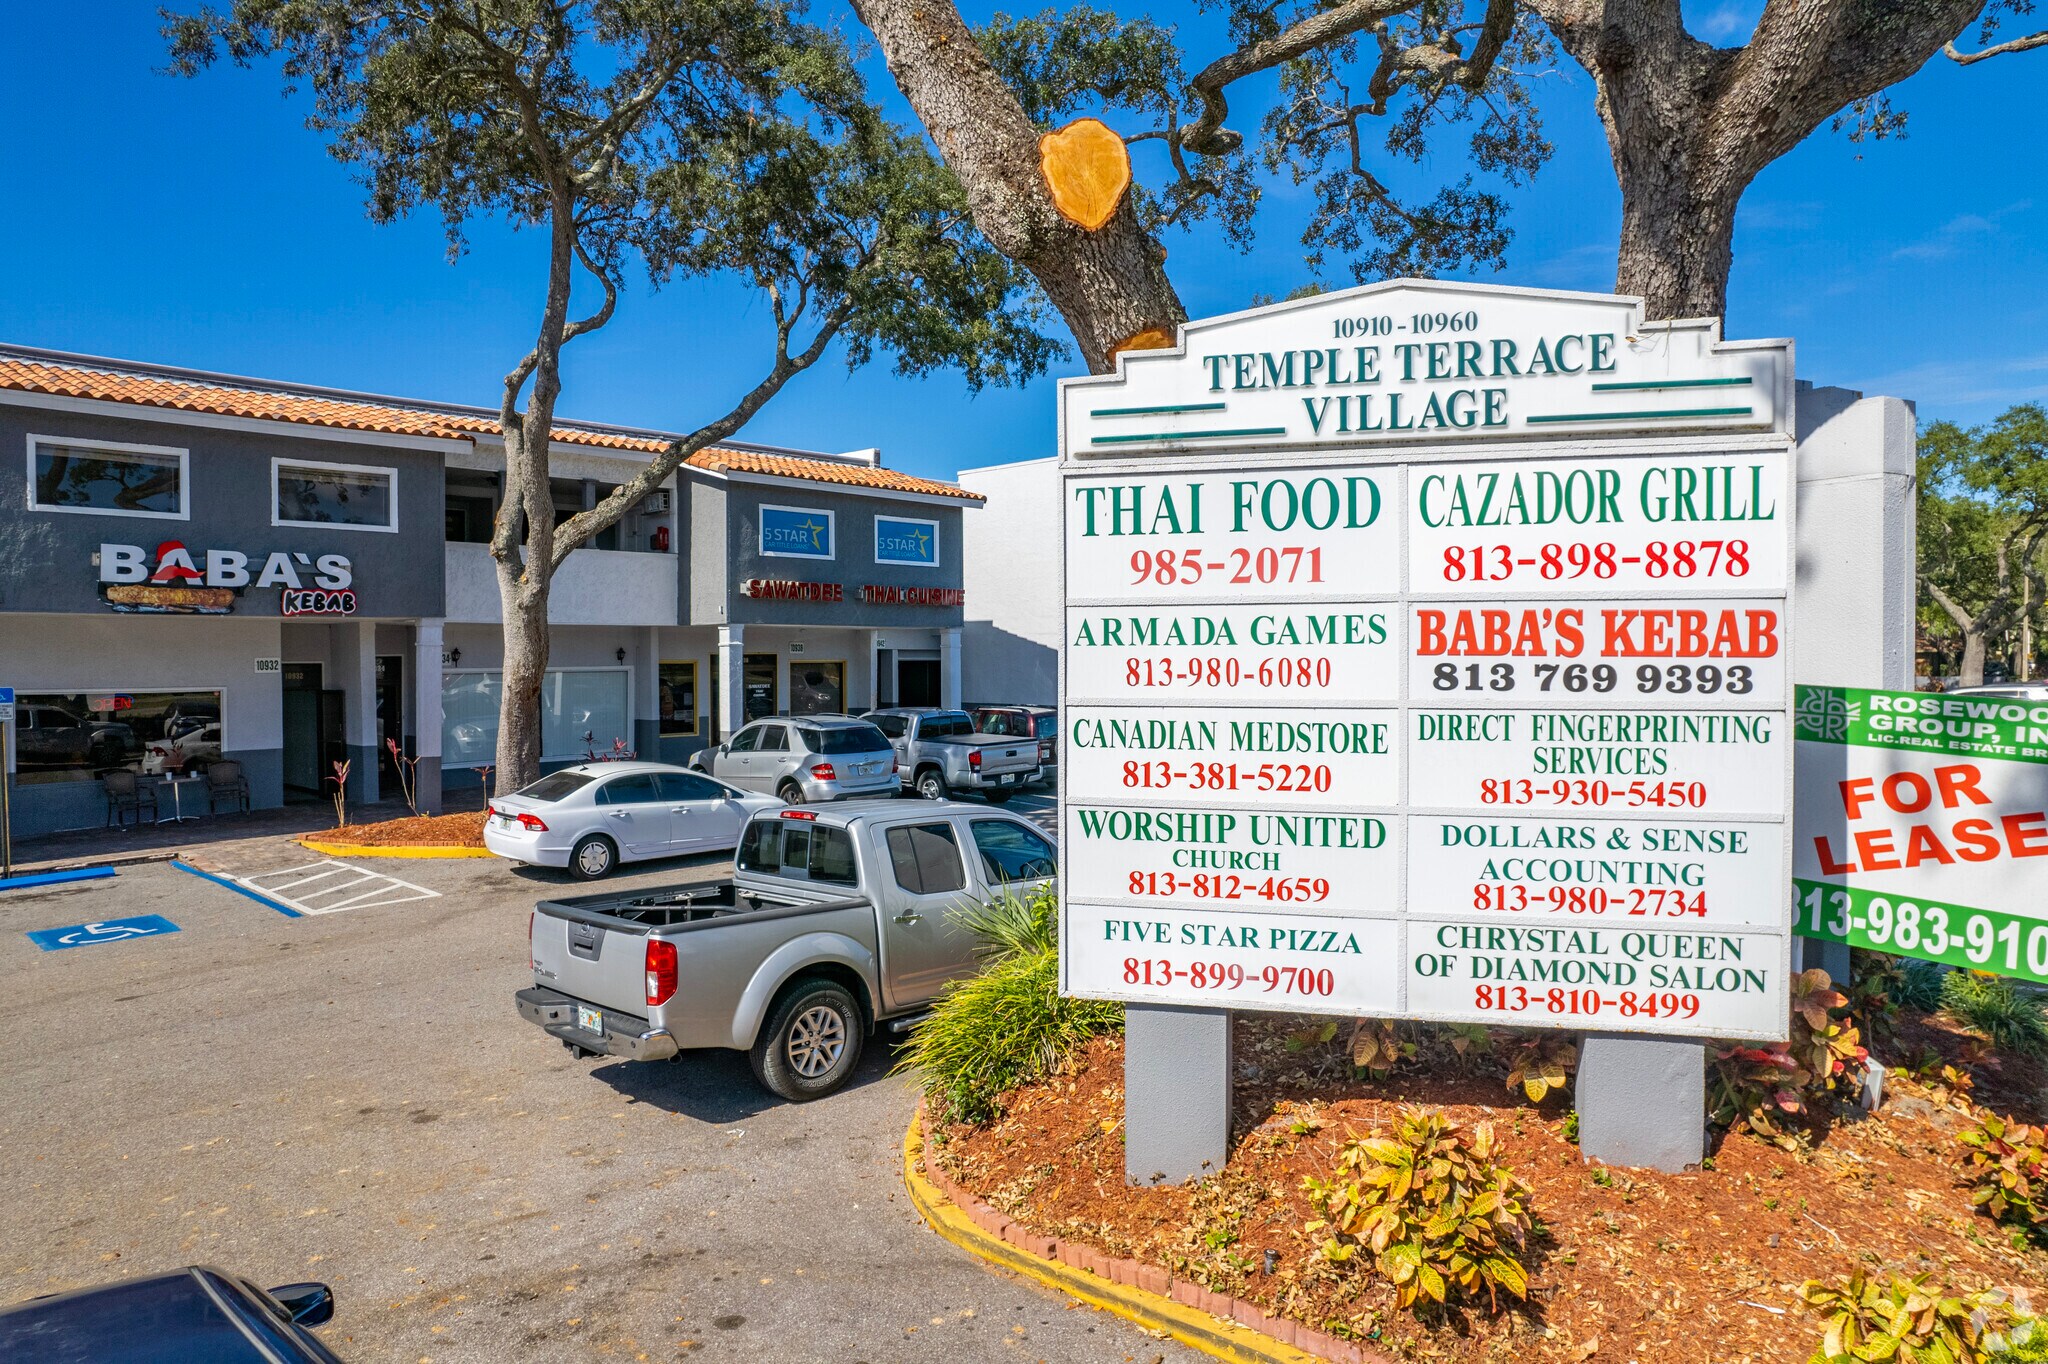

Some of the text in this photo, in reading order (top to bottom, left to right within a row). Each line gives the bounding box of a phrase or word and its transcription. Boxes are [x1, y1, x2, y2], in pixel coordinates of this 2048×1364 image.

[1204, 334, 1615, 390] TEMPLE TERRACE
[1303, 389, 1507, 432] VILLAGE
[1076, 477, 1380, 536] THAI FOOD
[1420, 466, 1774, 528] CAZADOR GRILL
[764, 528, 808, 542] 5 STAR
[879, 538, 915, 551] 5 STAR
[1131, 547, 1325, 585] 985-2071
[1443, 540, 1749, 581] 813-898-8878
[284, 591, 355, 615] KEBAB
[748, 579, 965, 606] SAWATDEE THAI CUISINE
[1075, 614, 1386, 646] ARMADA GAMES
[1417, 608, 1778, 658] BABA'S KEBAB
[256, 660, 279, 671] 10932
[1126, 658, 1330, 687] 813-980-6080
[1433, 663, 1752, 694] 813 769 9393
[94, 697, 132, 711] OPEN
[1074, 719, 1387, 753] CANADIAN MEDSTORE
[1419, 714, 1771, 743] DIRECT FINGERPRINTING
[1869, 714, 2000, 744] GROUP,
[1534, 747, 1667, 774] SERVICES
[1949, 741, 2016, 755] ESTATE
[1123, 761, 1331, 792] 813-381-5220
[1838, 764, 1993, 820] FOR
[1481, 779, 1706, 807] 813-930-5450
[1078, 810, 1386, 848] WORSHIP UNITED
[1443, 825, 1747, 853] DOLLARS & SENSE
[1813, 811, 2048, 876] LEASE
[1173, 850, 1278, 870] CHURCH
[1480, 859, 1703, 885] ACCOUNTING
[1129, 871, 1329, 902] 813-812-4659
[1474, 884, 1707, 917] 813-980-2734
[1106, 921, 1361, 953] FIVE STAR PIZZA
[1438, 926, 1741, 961] CHRYSTAL QUEEN
[1124, 958, 1334, 995] 813-899-9700
[1416, 954, 1765, 992] OF DIAMOND SALON
[1475, 985, 1700, 1018] 813-810-8499
